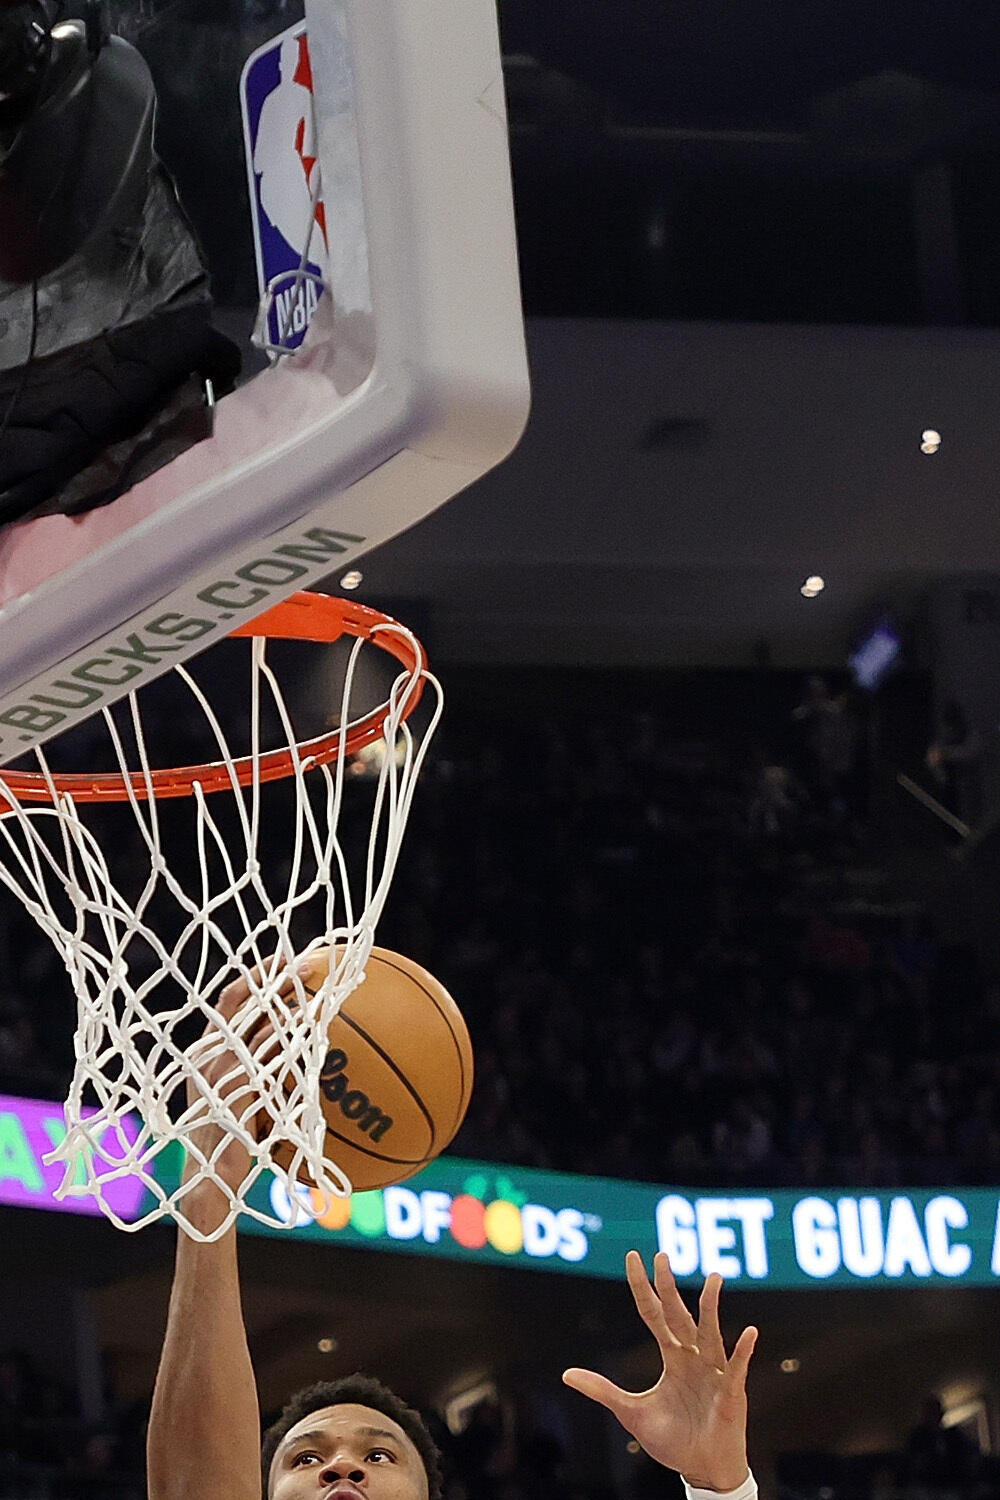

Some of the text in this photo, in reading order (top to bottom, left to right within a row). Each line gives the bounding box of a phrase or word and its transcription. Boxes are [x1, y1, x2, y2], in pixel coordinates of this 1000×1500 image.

[318, 1047, 394, 1143] lson
[655, 1193, 775, 1280] GET
[791, 1195, 974, 1280] GUAC
